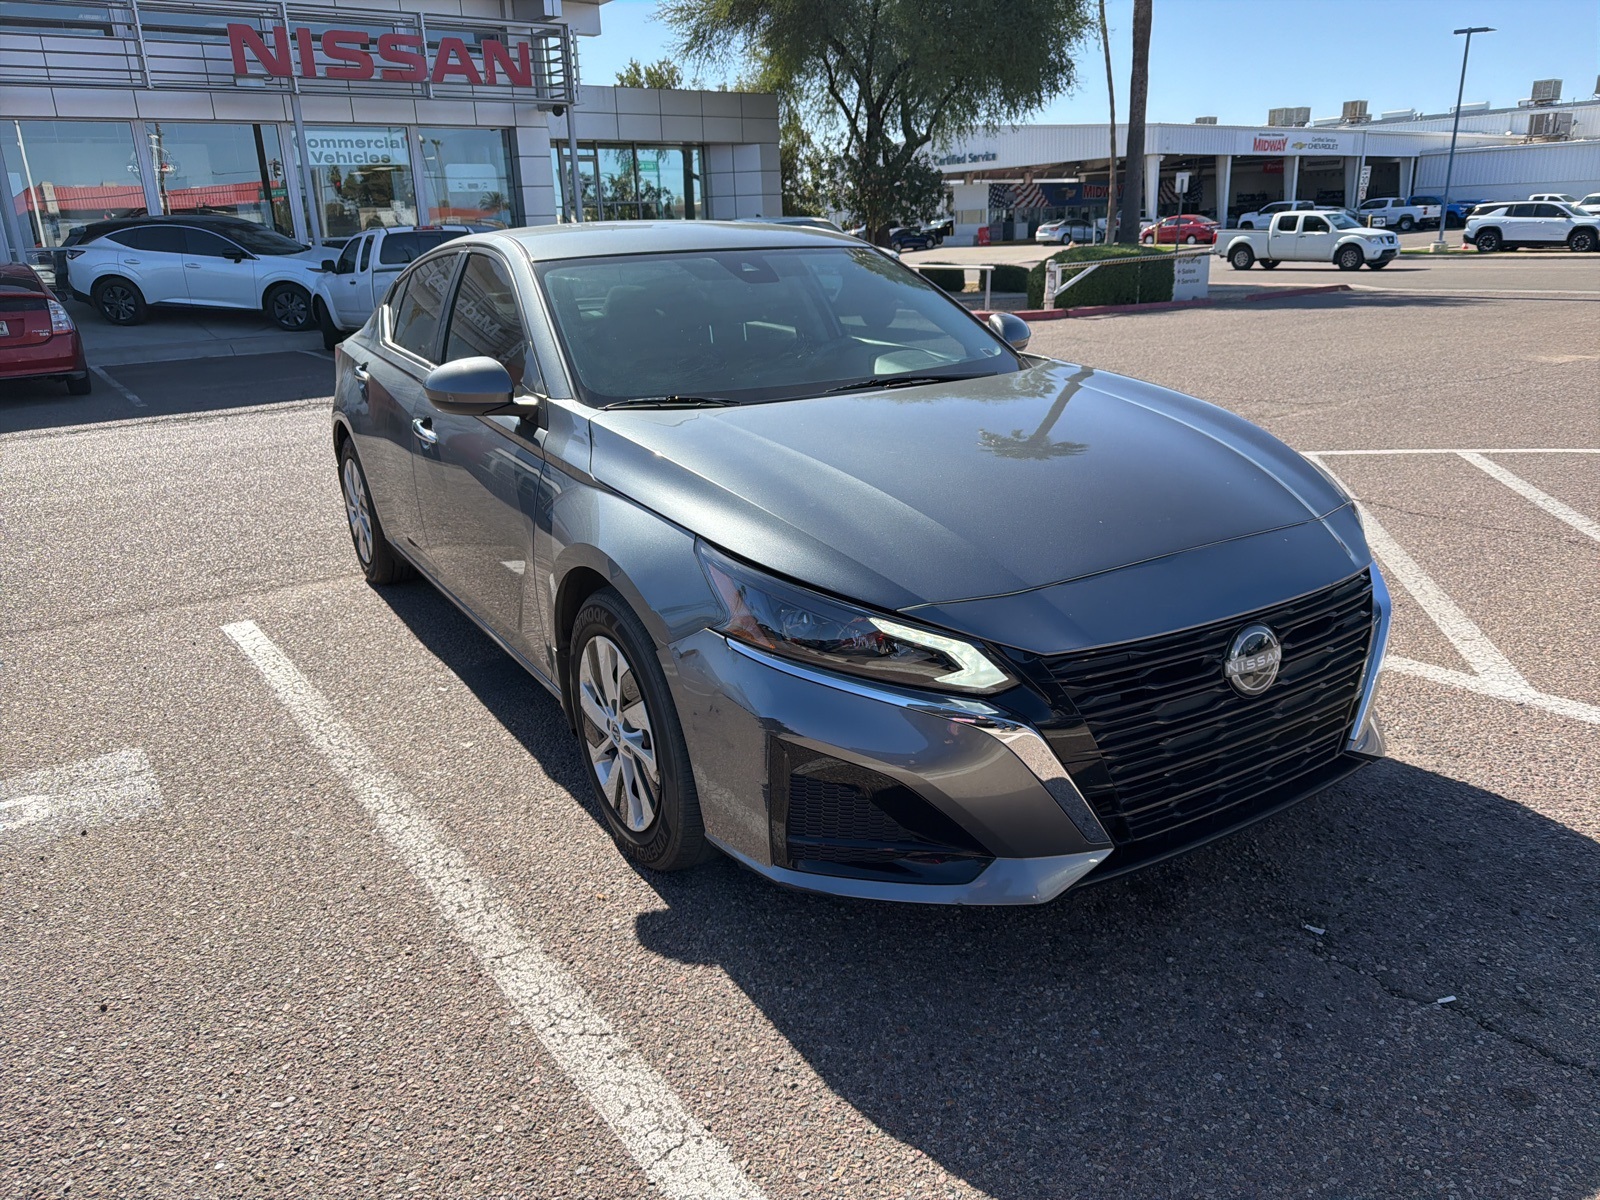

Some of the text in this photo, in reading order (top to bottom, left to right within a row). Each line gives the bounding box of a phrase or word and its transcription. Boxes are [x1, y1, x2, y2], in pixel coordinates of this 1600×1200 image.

[226, 22, 533, 87] NISSAN
[1253, 137, 1288, 151] MIDWAY
[311, 151, 391, 164] Vehicles
[968, 151, 997, 163] Service
[1083, 184, 1125, 199] MIDWY
[1227, 649, 1281, 674] NISSAN
